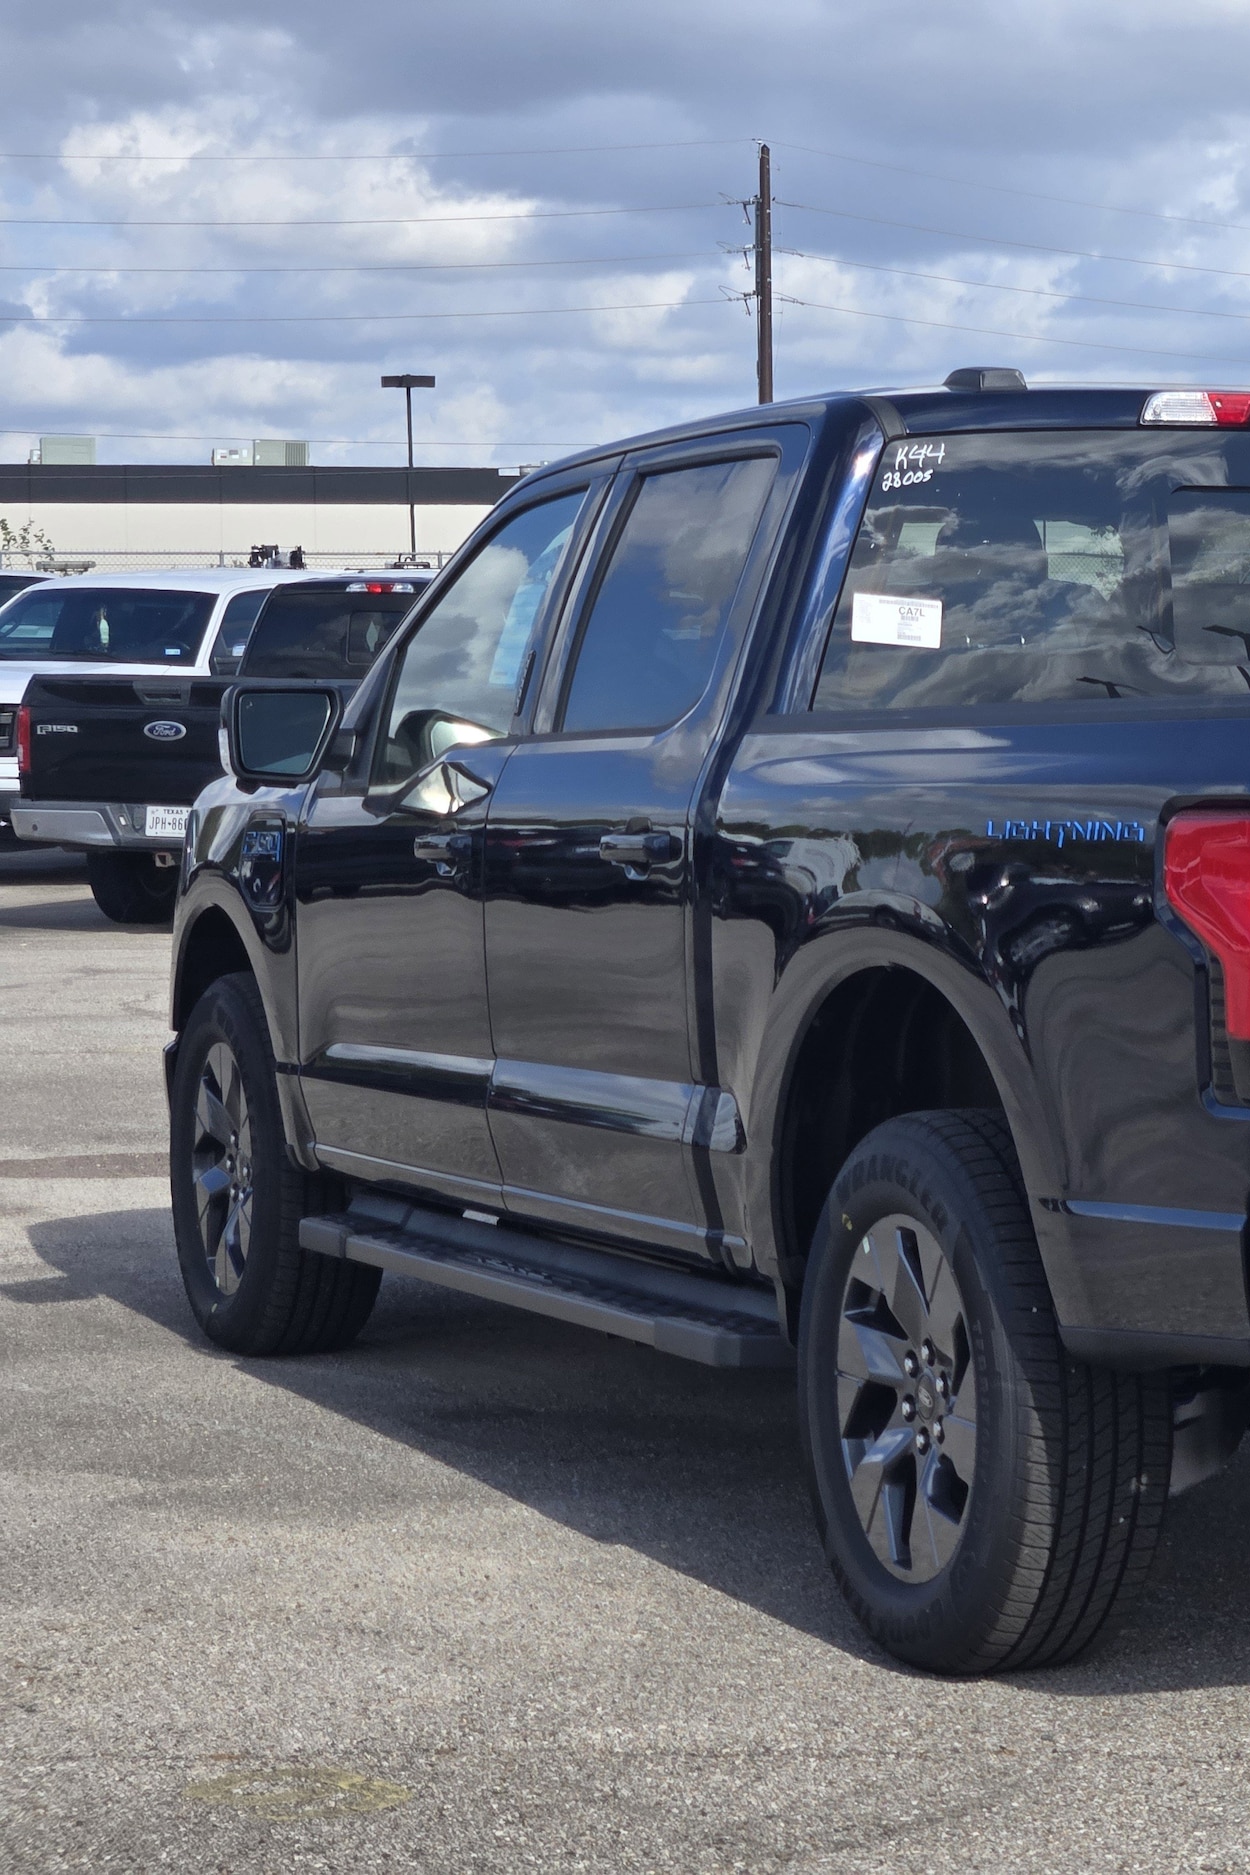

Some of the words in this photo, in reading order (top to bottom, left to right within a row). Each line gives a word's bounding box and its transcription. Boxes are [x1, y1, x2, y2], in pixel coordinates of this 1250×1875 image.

[895, 443, 945, 470] K44
[882, 469, 933, 491] 28005
[898, 606, 925, 617] CA7L
[153, 724, 176, 736] Ford
[987, 820, 1144, 848] LIGHTNING
